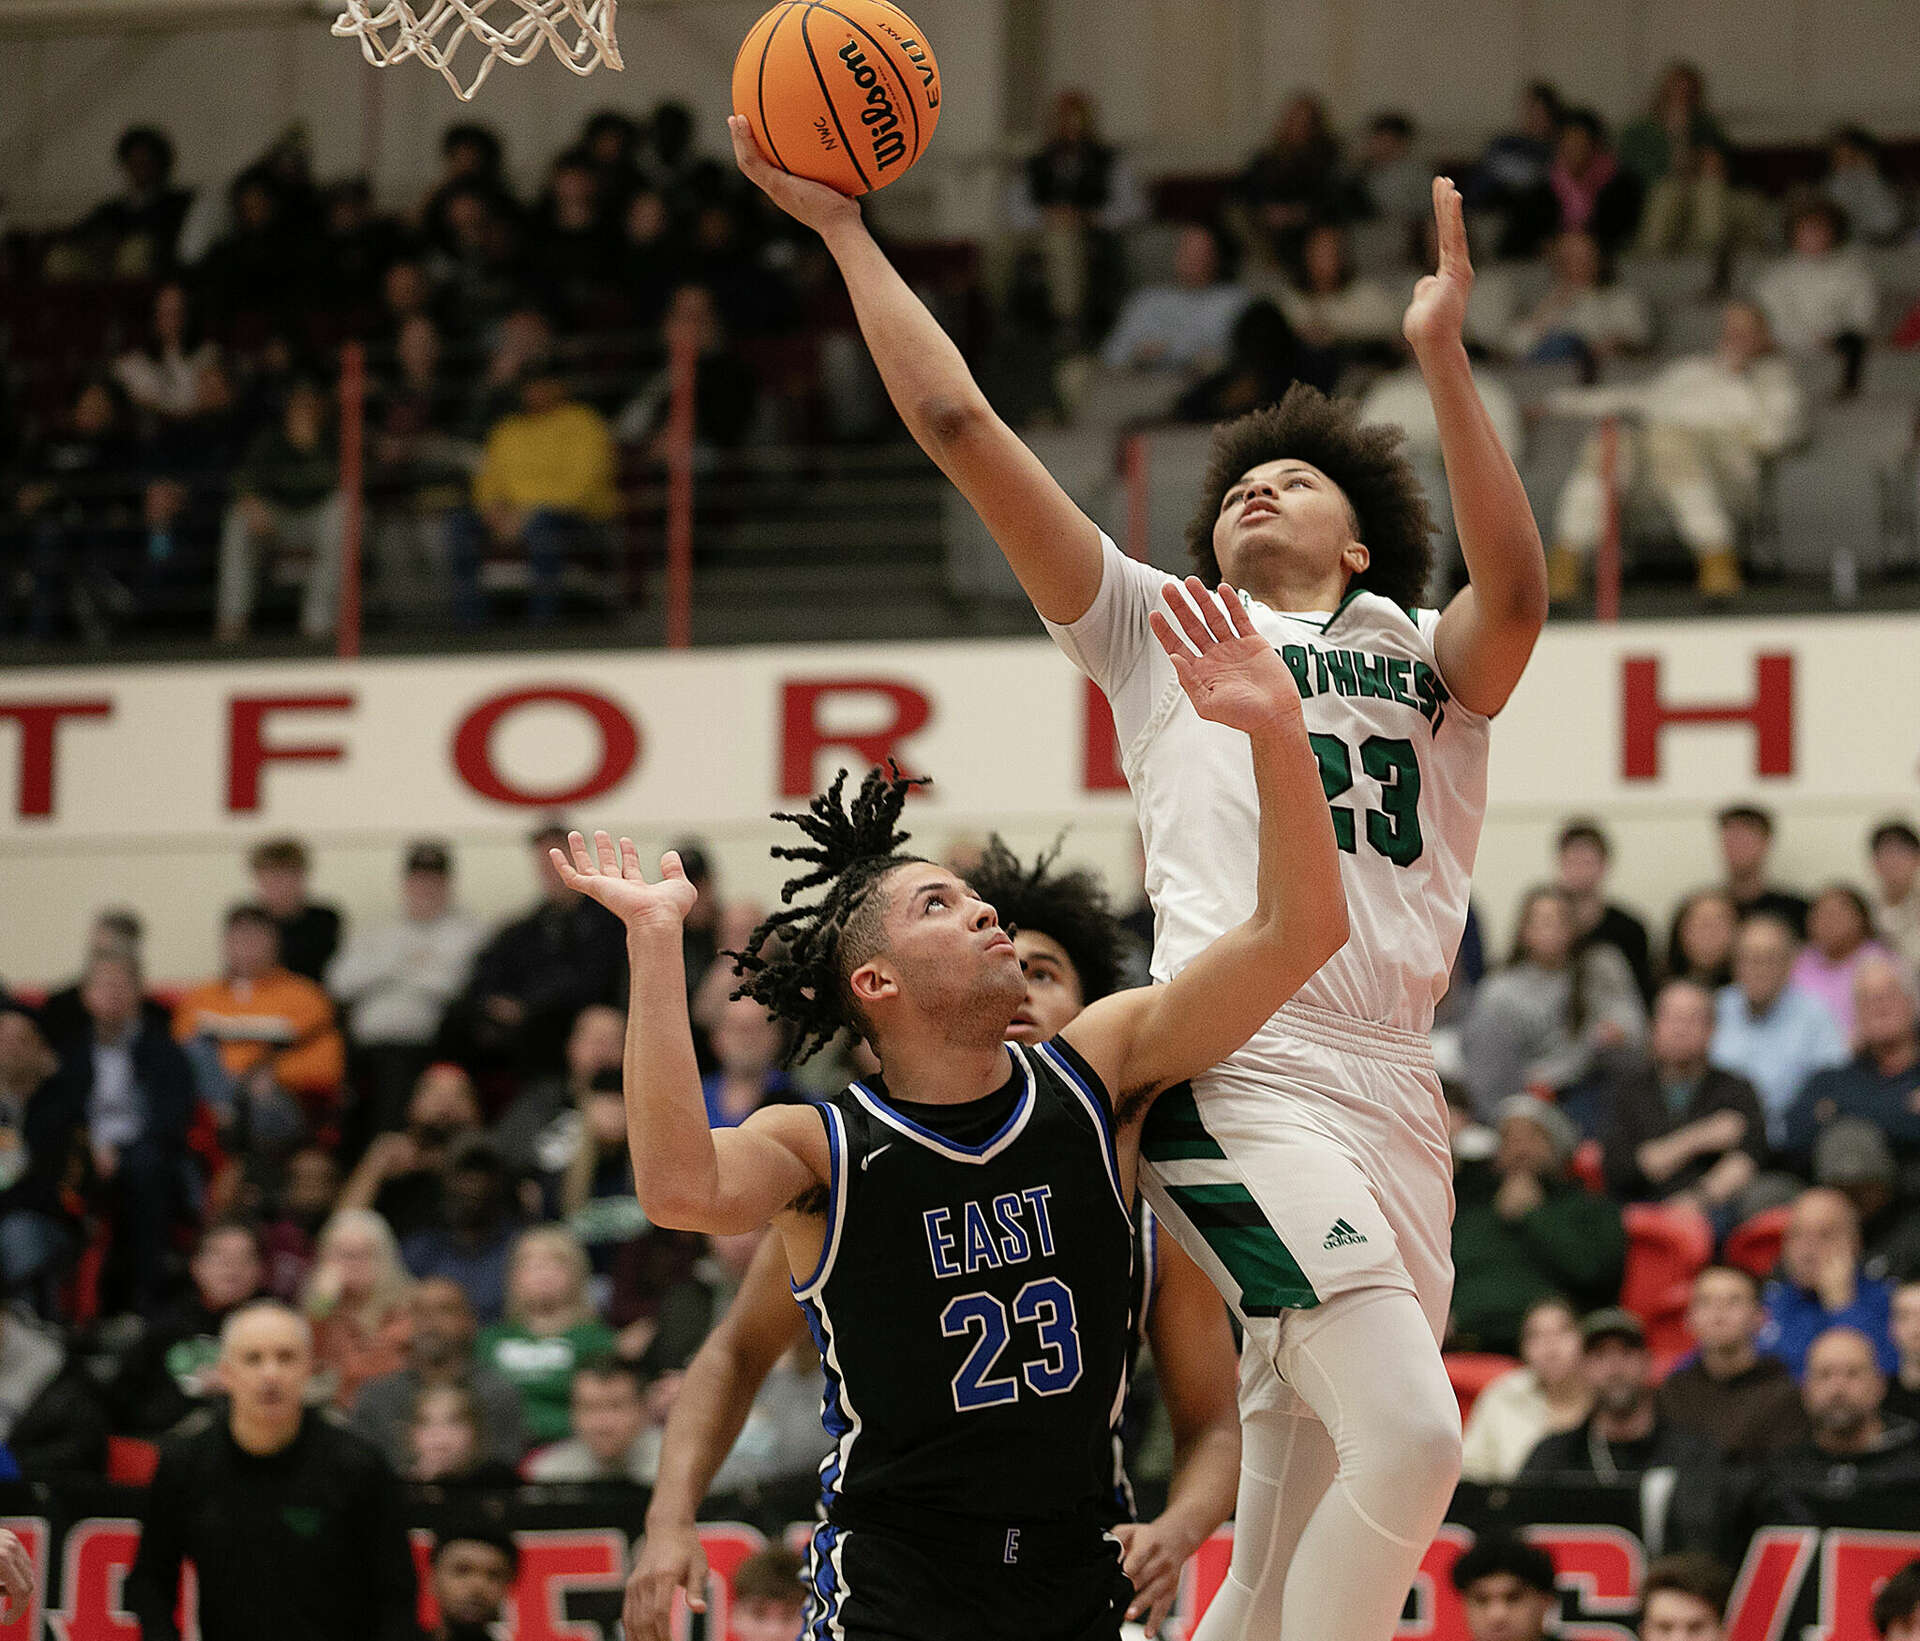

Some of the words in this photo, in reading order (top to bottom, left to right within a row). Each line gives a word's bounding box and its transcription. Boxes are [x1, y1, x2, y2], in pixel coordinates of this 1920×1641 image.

[838, 39, 907, 172] Wilson
[900, 38, 939, 109] EVO
[813, 116, 838, 151] NWC
[0, 674, 1132, 817] TFOR
[1308, 731, 1444, 869] 23
[923, 1184, 1055, 1280] EAST
[1323, 1233, 1368, 1250] adidas
[940, 1276, 1084, 1413] 23
[1003, 1528, 1021, 1564] E
